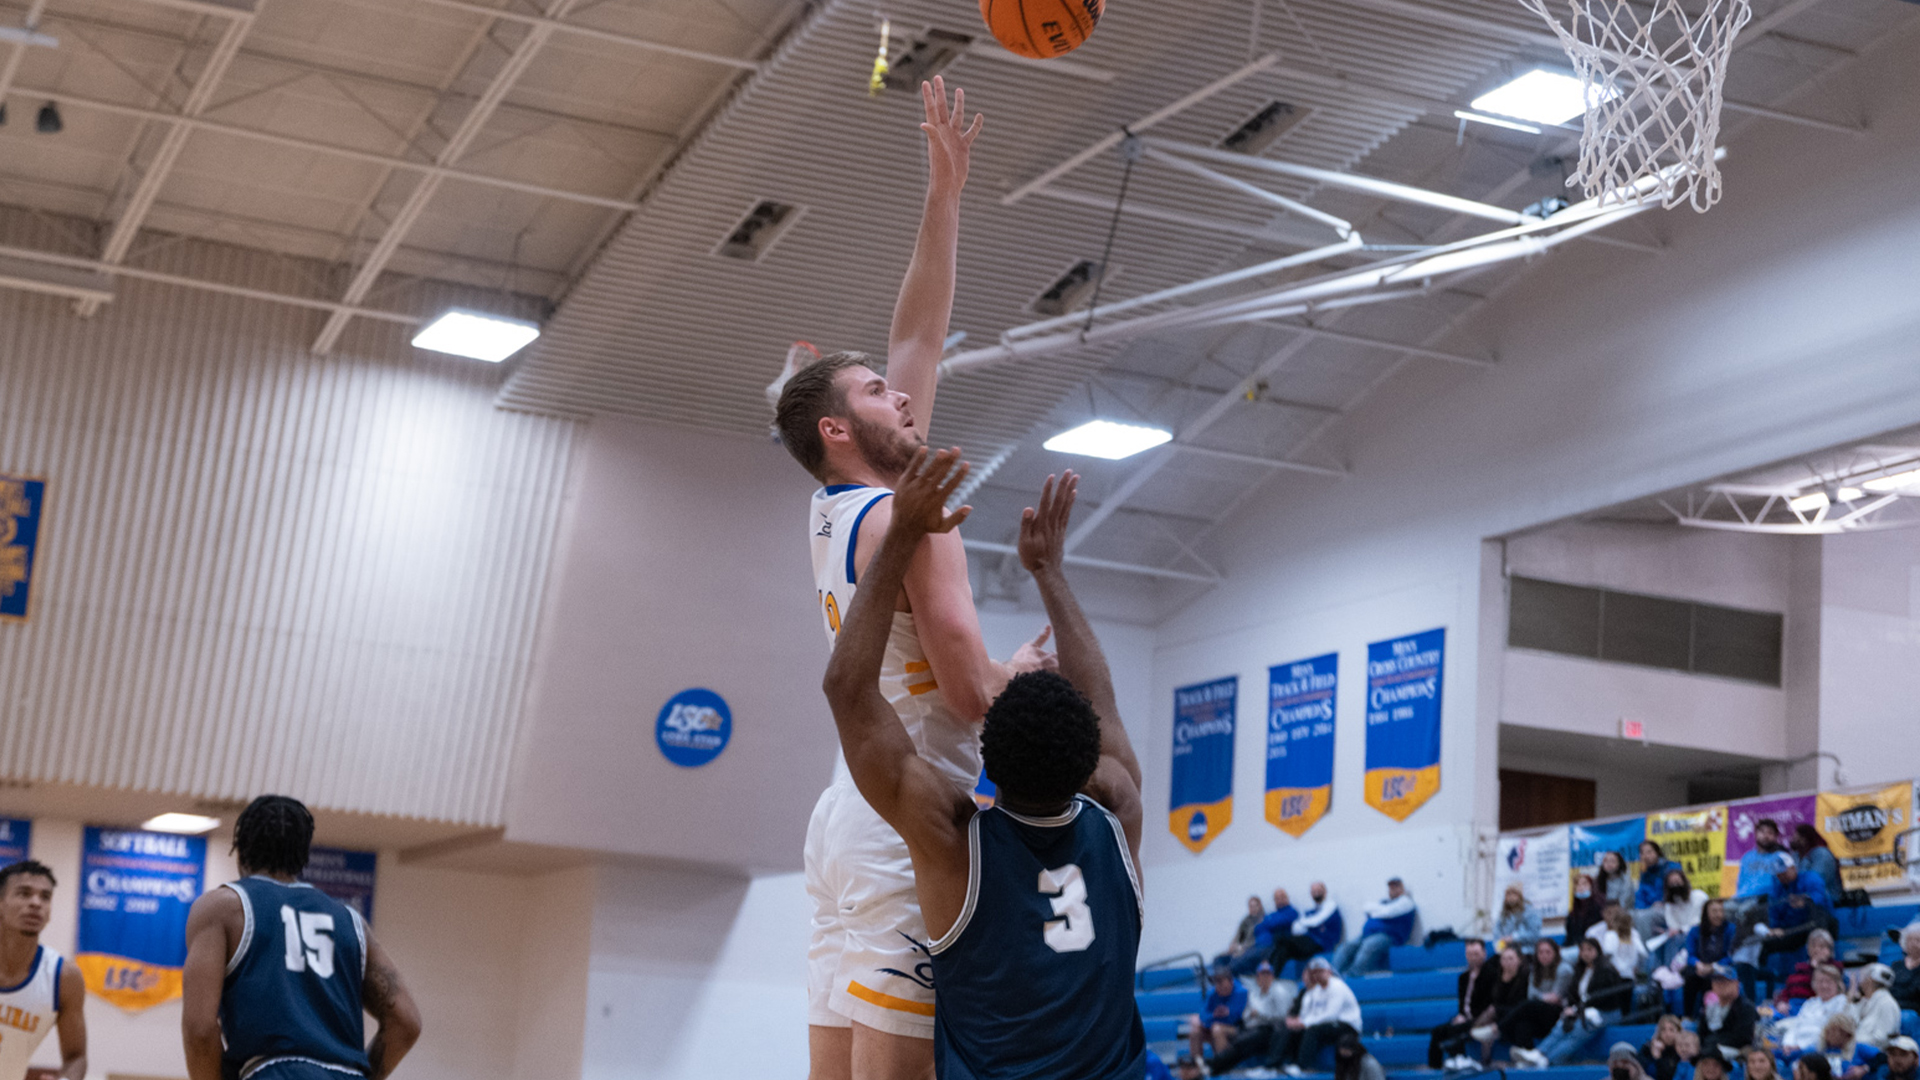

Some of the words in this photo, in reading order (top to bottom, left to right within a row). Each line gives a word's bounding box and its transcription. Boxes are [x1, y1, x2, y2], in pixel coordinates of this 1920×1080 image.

[100, 830, 190, 859] SOFTBALL
[280, 904, 335, 979] 15
[1037, 864, 1096, 953] 3
